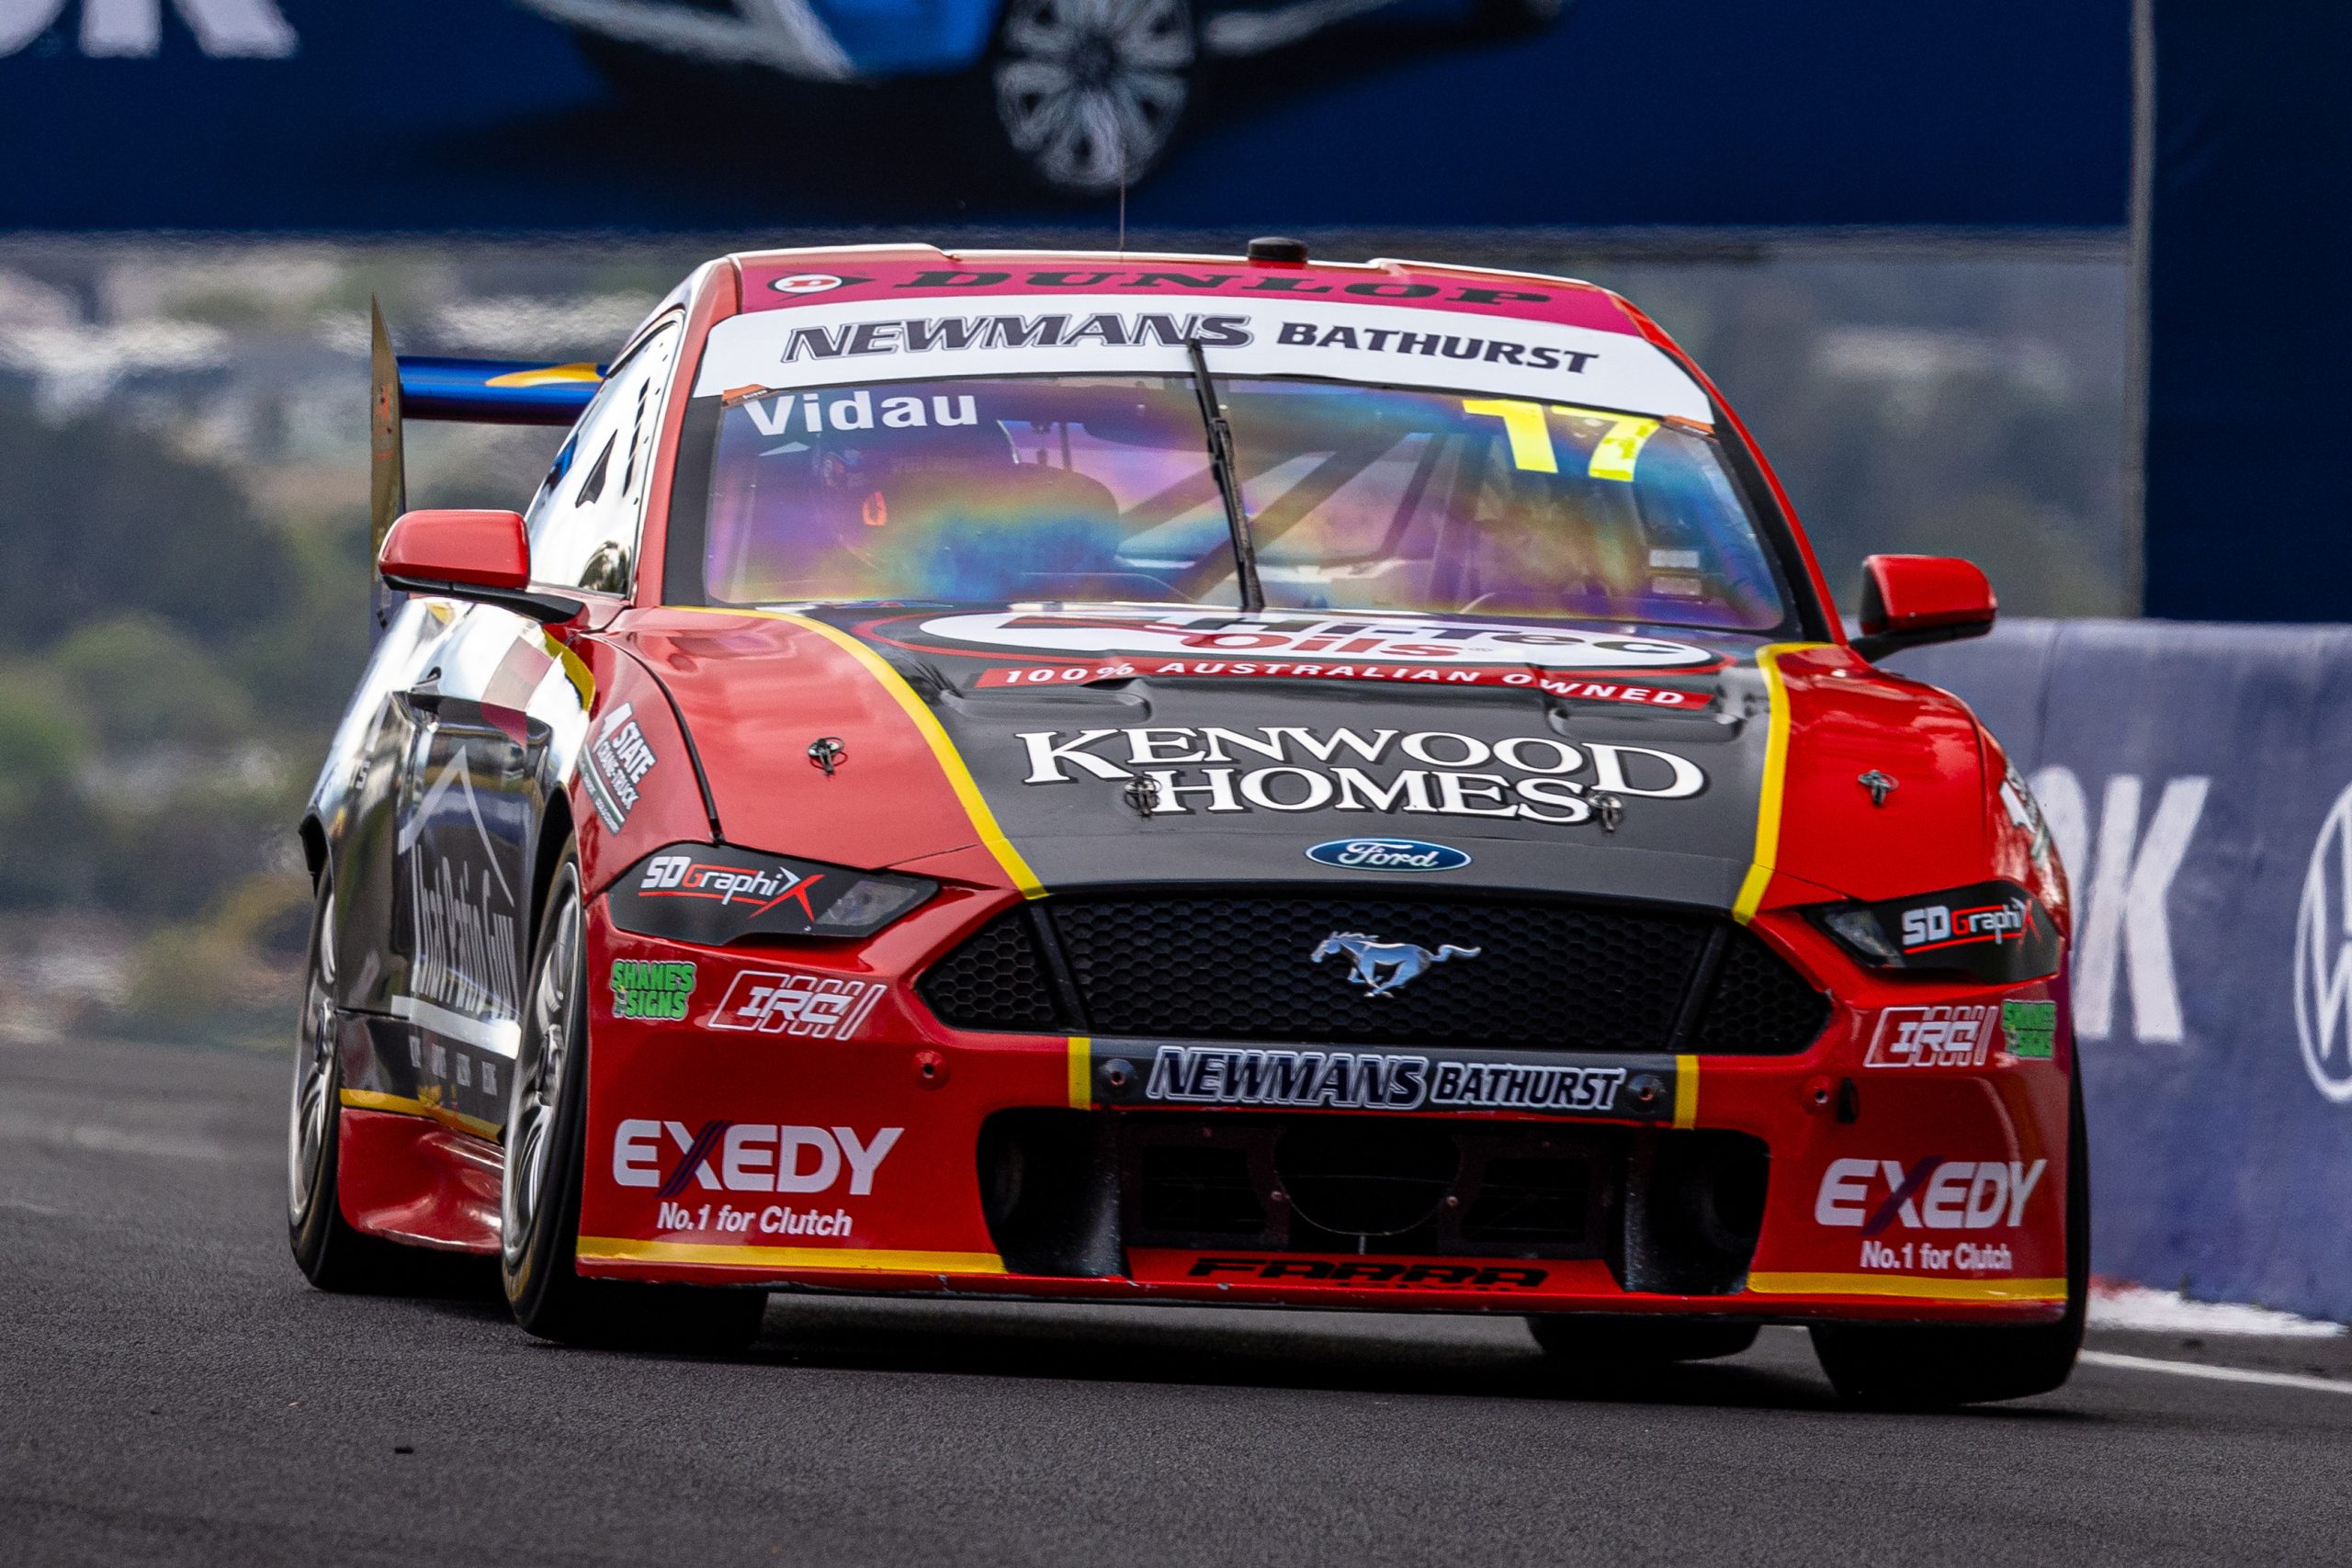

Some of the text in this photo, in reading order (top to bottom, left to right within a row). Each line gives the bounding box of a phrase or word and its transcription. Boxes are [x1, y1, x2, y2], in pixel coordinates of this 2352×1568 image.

[892, 270, 1552, 305] DUNLOP
[781, 312, 1600, 375] NEWMANS BATHURST
[742, 390, 978, 437] Vidau
[1463, 398, 1659, 481] 17
[1004, 661, 1687, 705] 100% AUSTRALIAN OWNED
[612, 720, 657, 784] STATE
[1015, 727, 1707, 799] KENWOOD
[1151, 766, 1596, 827] HOMES
[1335, 842, 1442, 871] Ford
[1147, 1047, 1626, 1111] NEWMANS BATHURST
[613, 1119, 905, 1198] EXEDY
[657, 1201, 853, 1237] No.1 for Clutch
[1815, 1156, 2049, 1236] EXEDY
[1860, 1241, 2012, 1271] No.1 for Clutch
